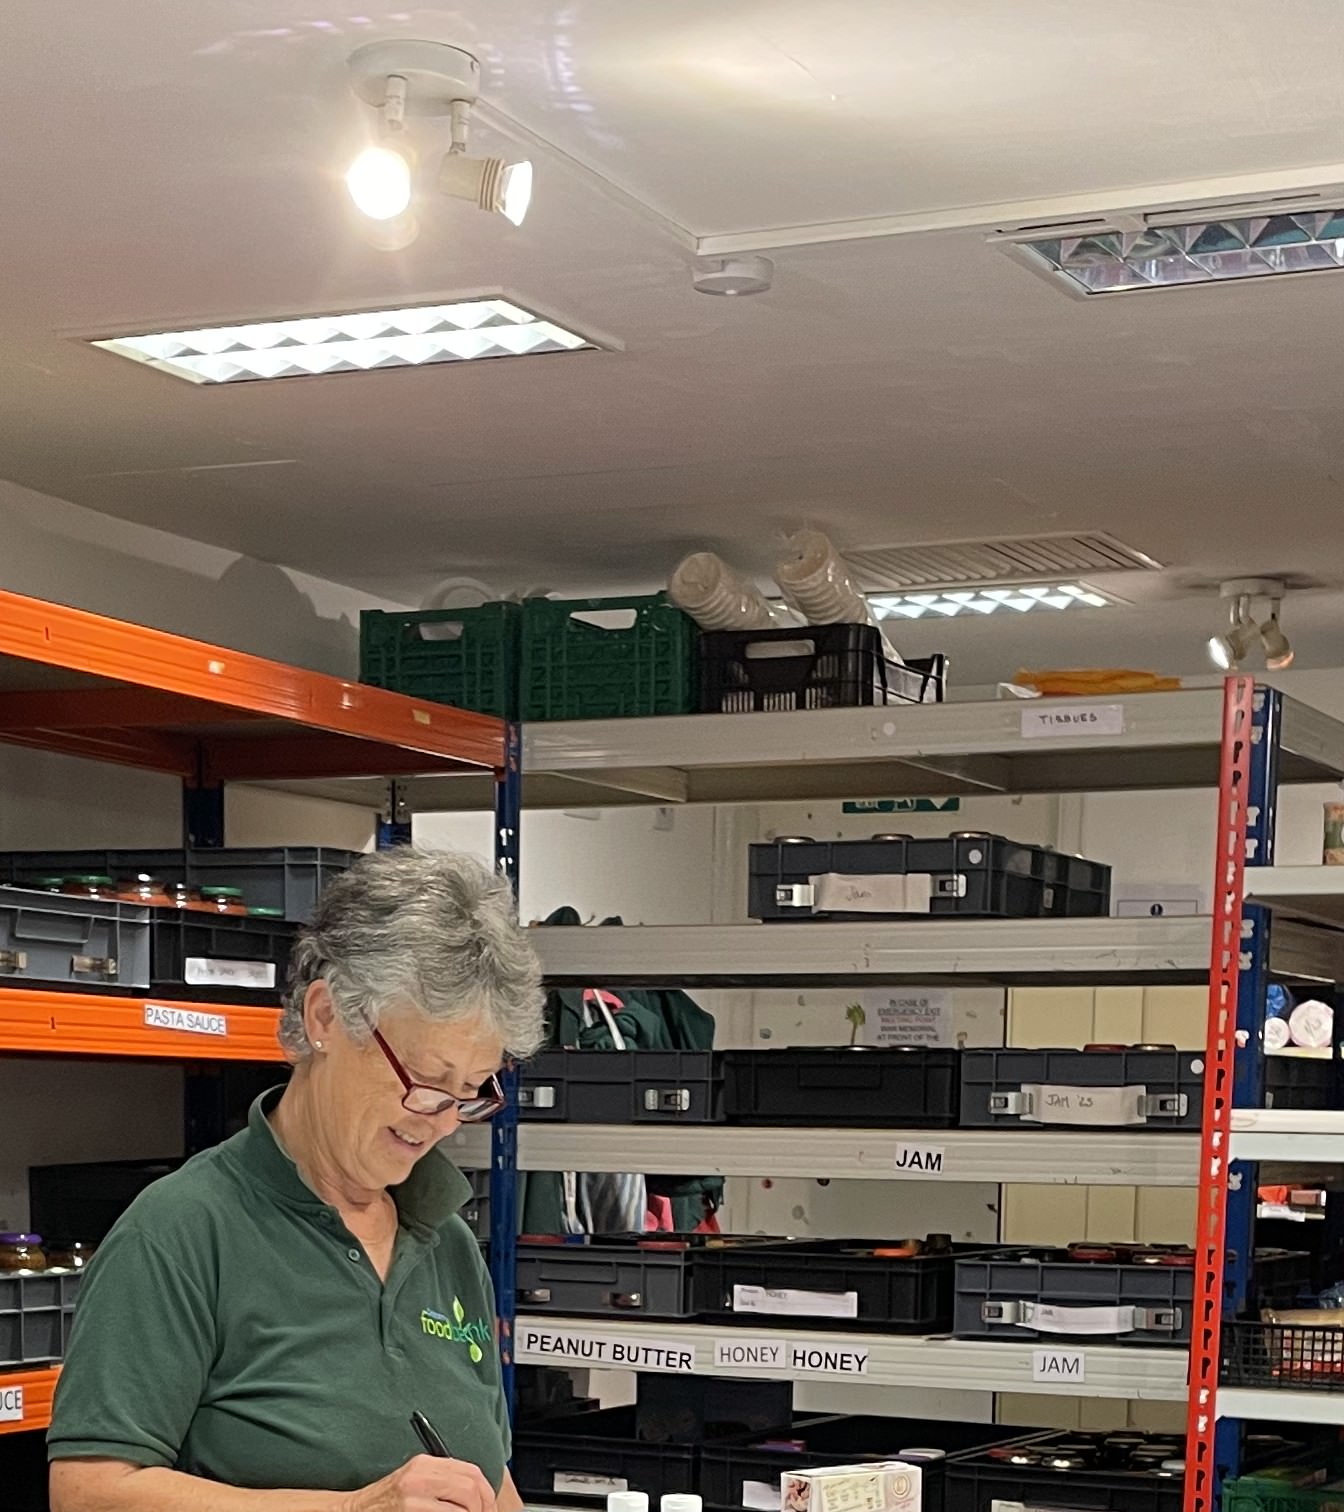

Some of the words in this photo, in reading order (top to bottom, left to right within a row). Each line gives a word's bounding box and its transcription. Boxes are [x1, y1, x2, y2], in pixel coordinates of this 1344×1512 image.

[1038, 713, 1098, 725] TISSUES
[146, 1008, 185, 1027] PASTA
[187, 1013, 225, 1034] SAUCE
[896, 1150, 943, 1172] JAM
[526, 1333, 606, 1360] PEANUT
[612, 1344, 693, 1370] BUTTER
[719, 1346, 779, 1363] HONEY
[792, 1349, 868, 1373] HONEY
[1039, 1356, 1080, 1375] JAM
